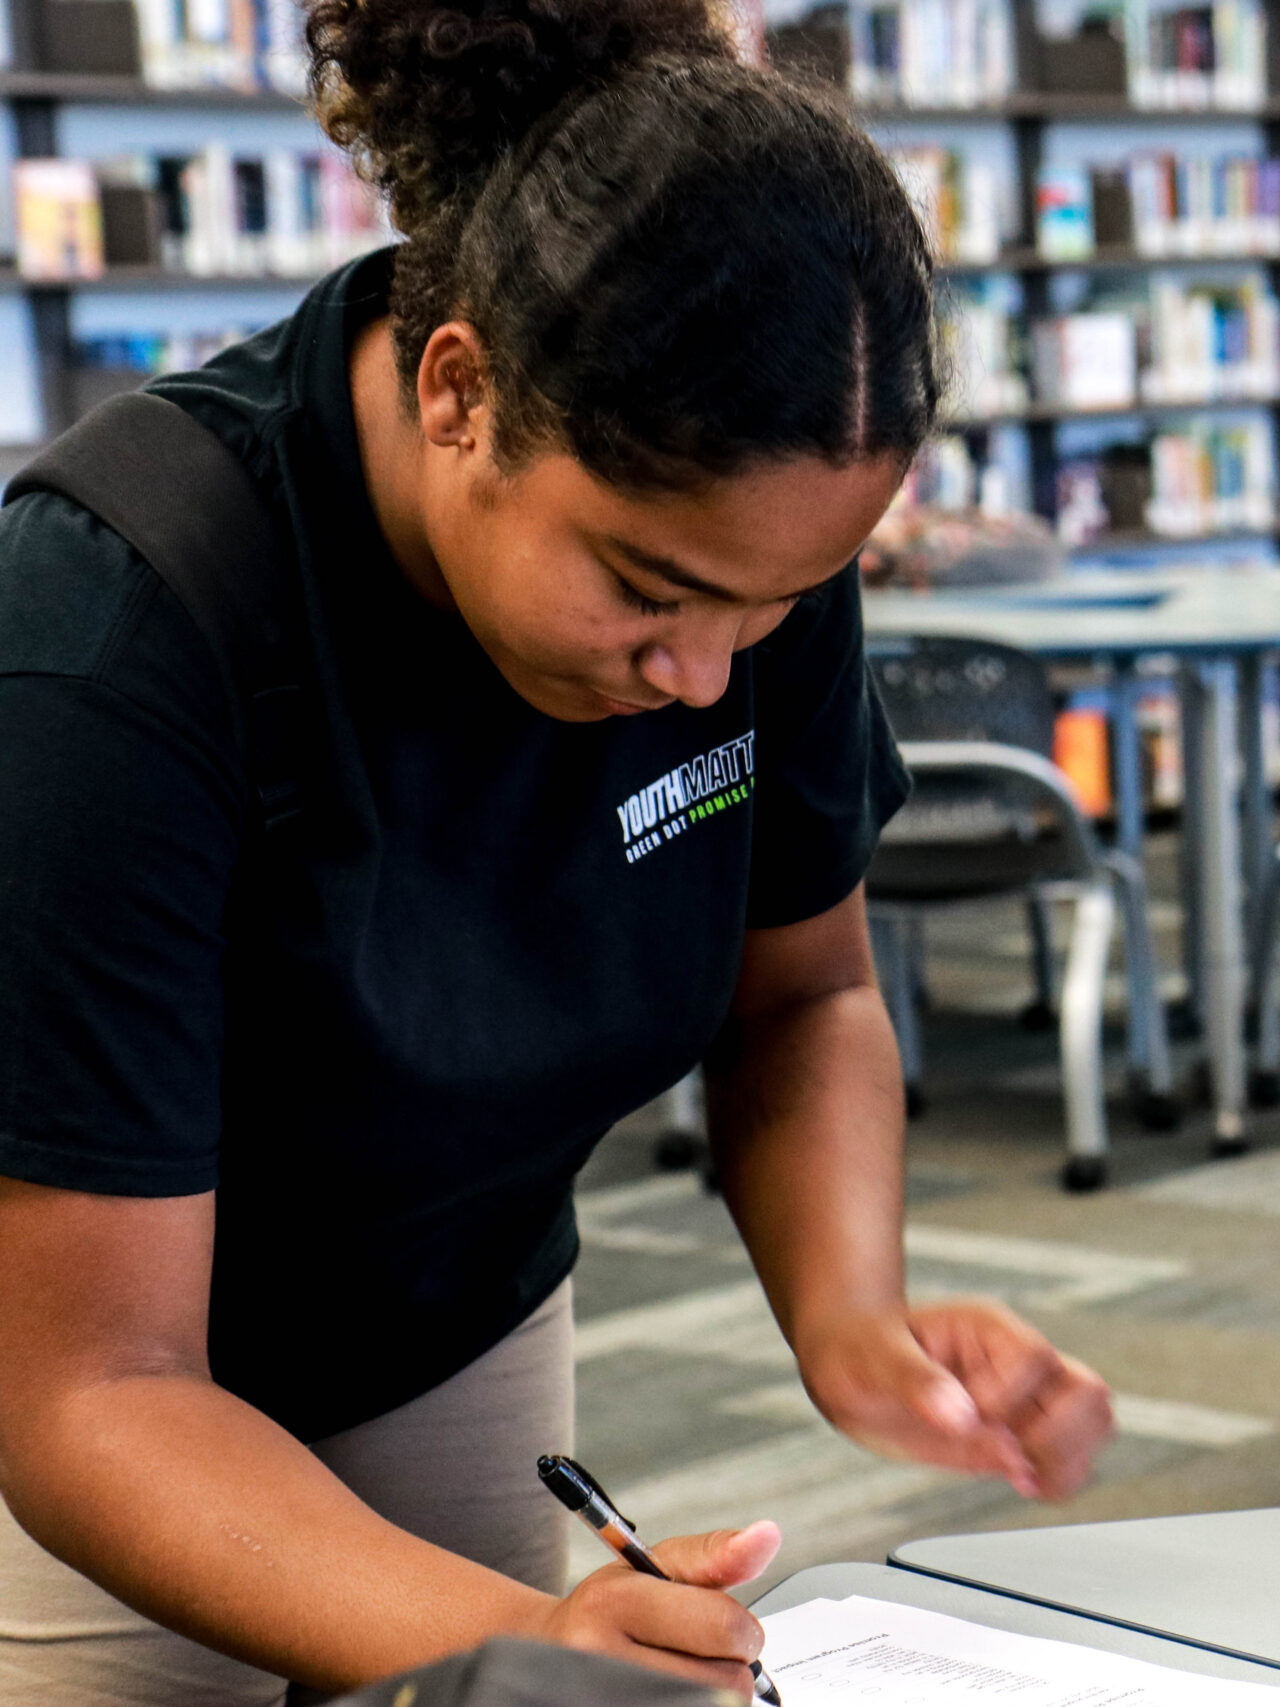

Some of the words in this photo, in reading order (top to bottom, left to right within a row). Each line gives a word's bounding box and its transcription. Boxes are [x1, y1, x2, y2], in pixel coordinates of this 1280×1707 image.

[625, 831, 662, 864] GREEN
[662, 815, 688, 840] DOT
[688, 784, 749, 823] PROMISE
